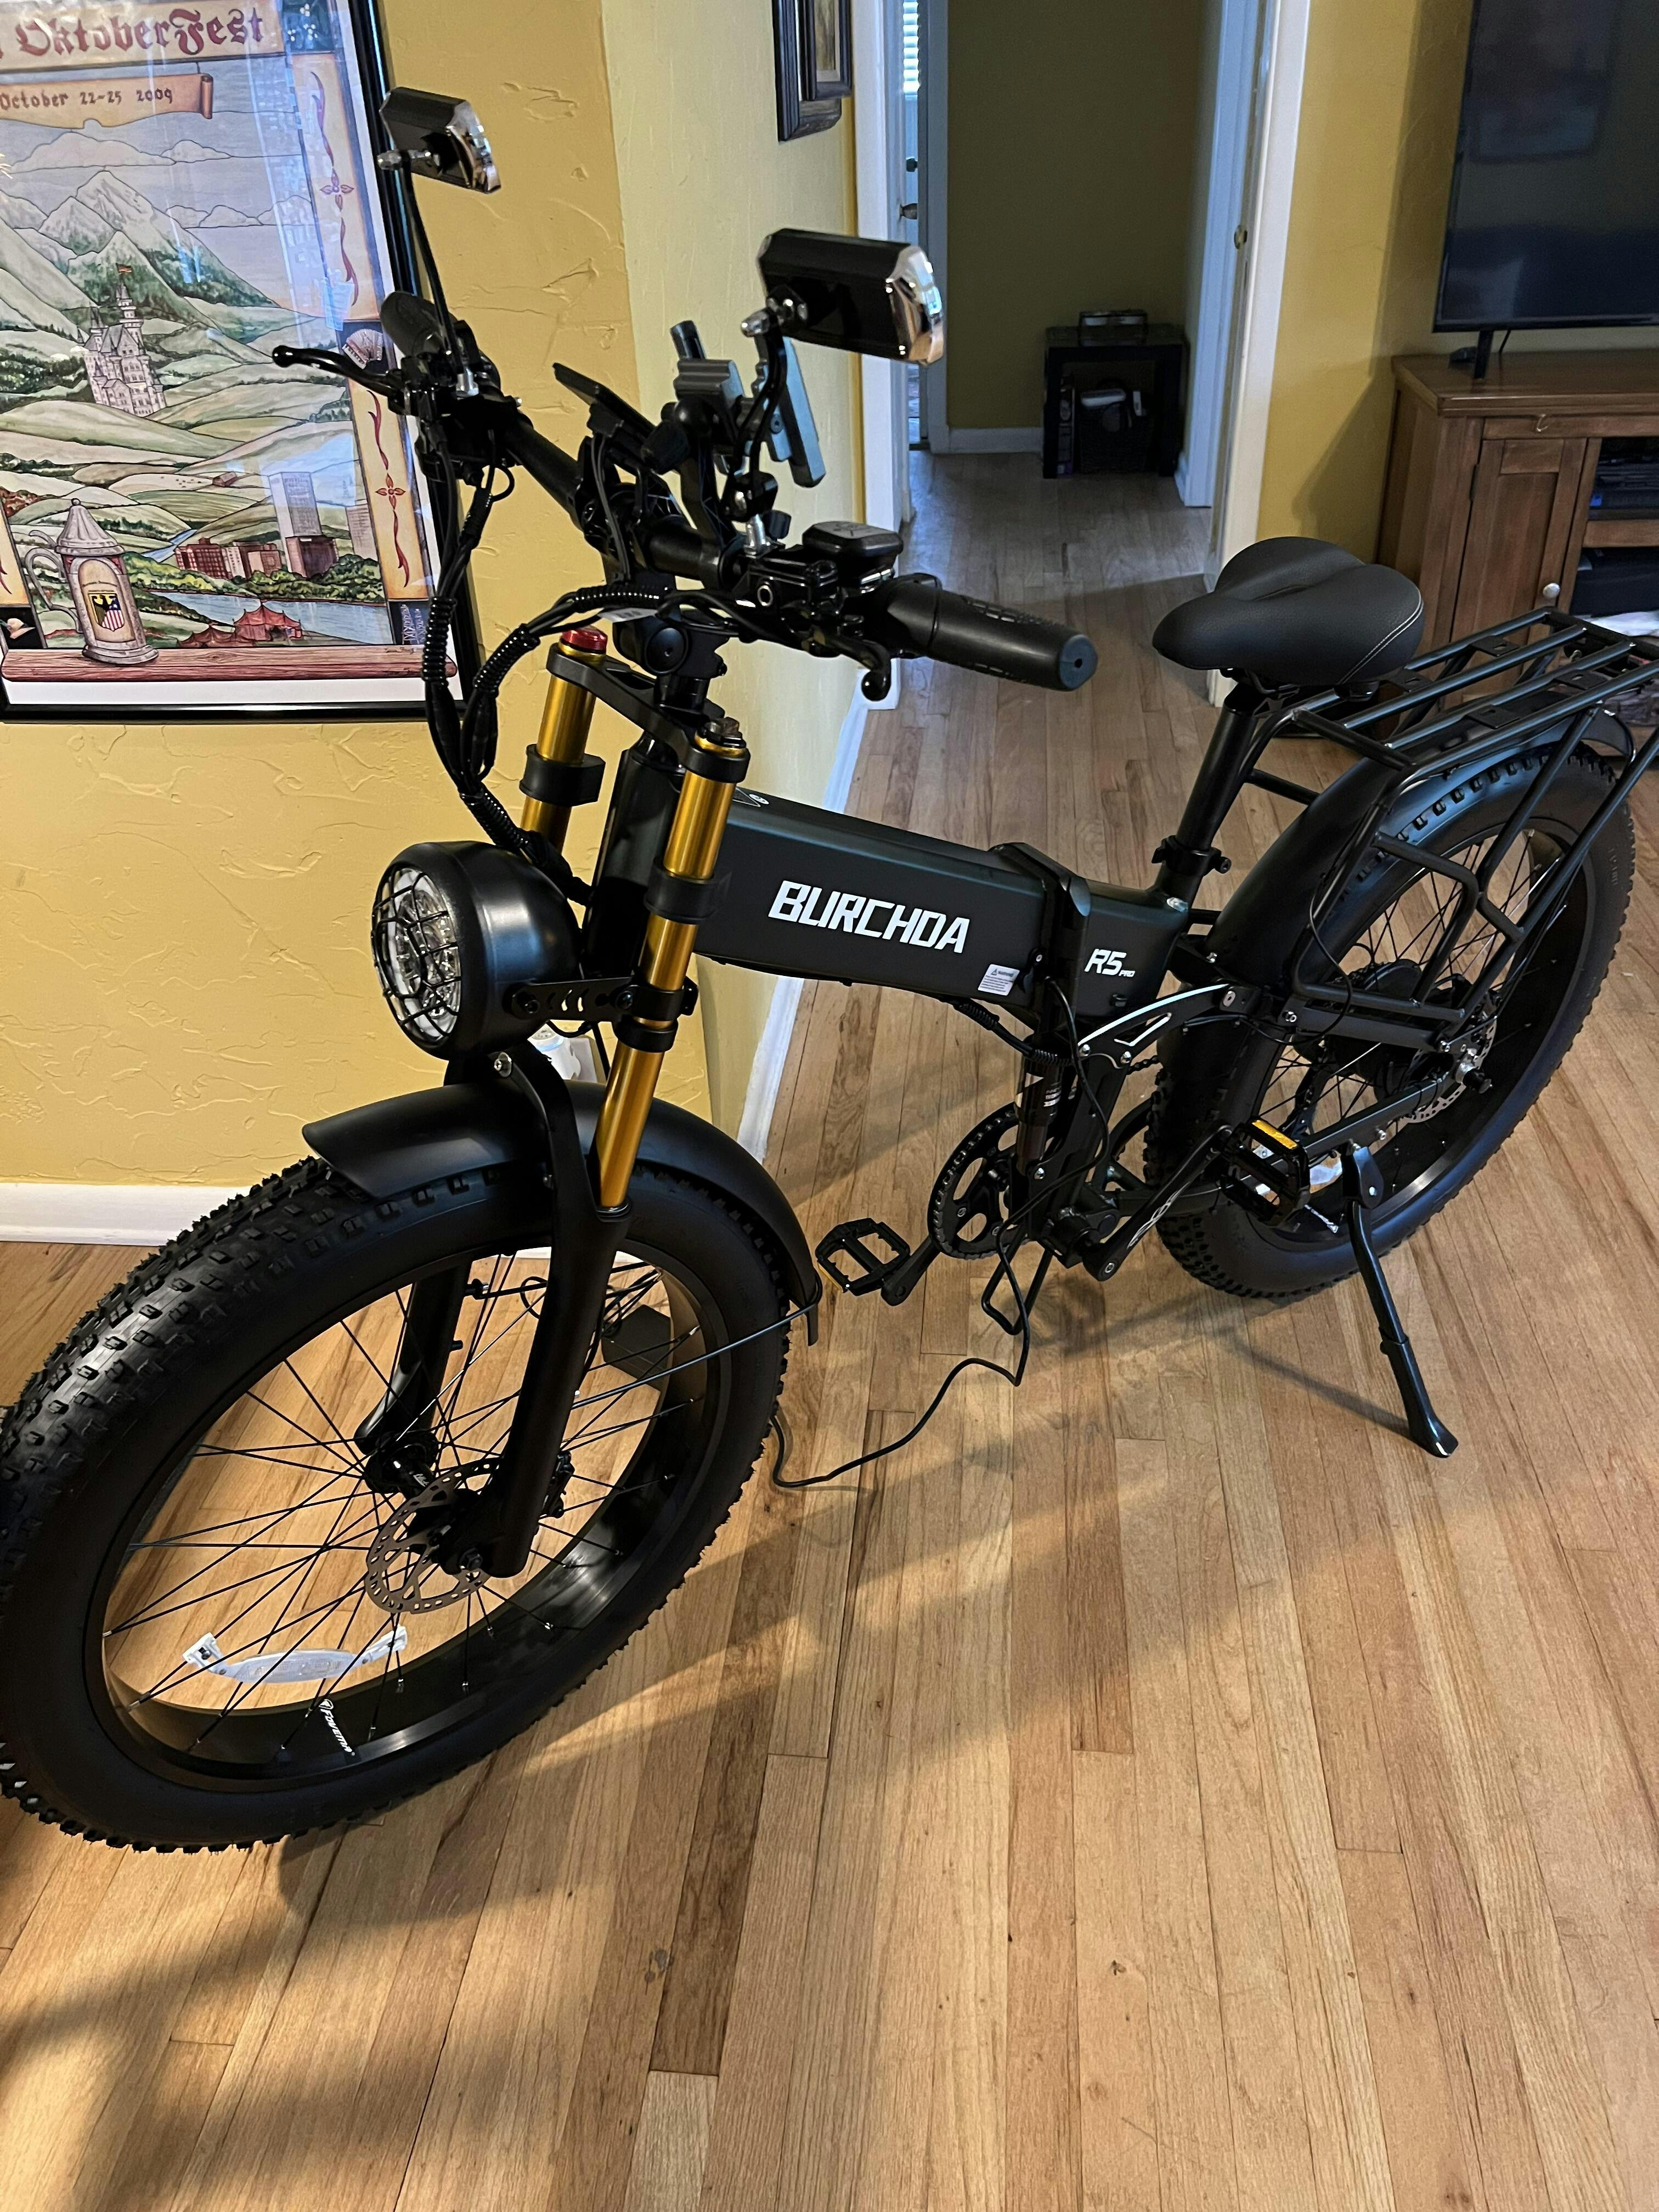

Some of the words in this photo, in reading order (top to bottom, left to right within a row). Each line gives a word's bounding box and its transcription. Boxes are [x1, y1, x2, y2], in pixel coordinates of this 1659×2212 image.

[0, 89, 68, 110] October
[80, 91, 122, 105] 22-25
[137, 88, 173, 104] 2009
[768, 880, 970, 953] BURCHDA
[1084, 949, 1127, 975] R5
